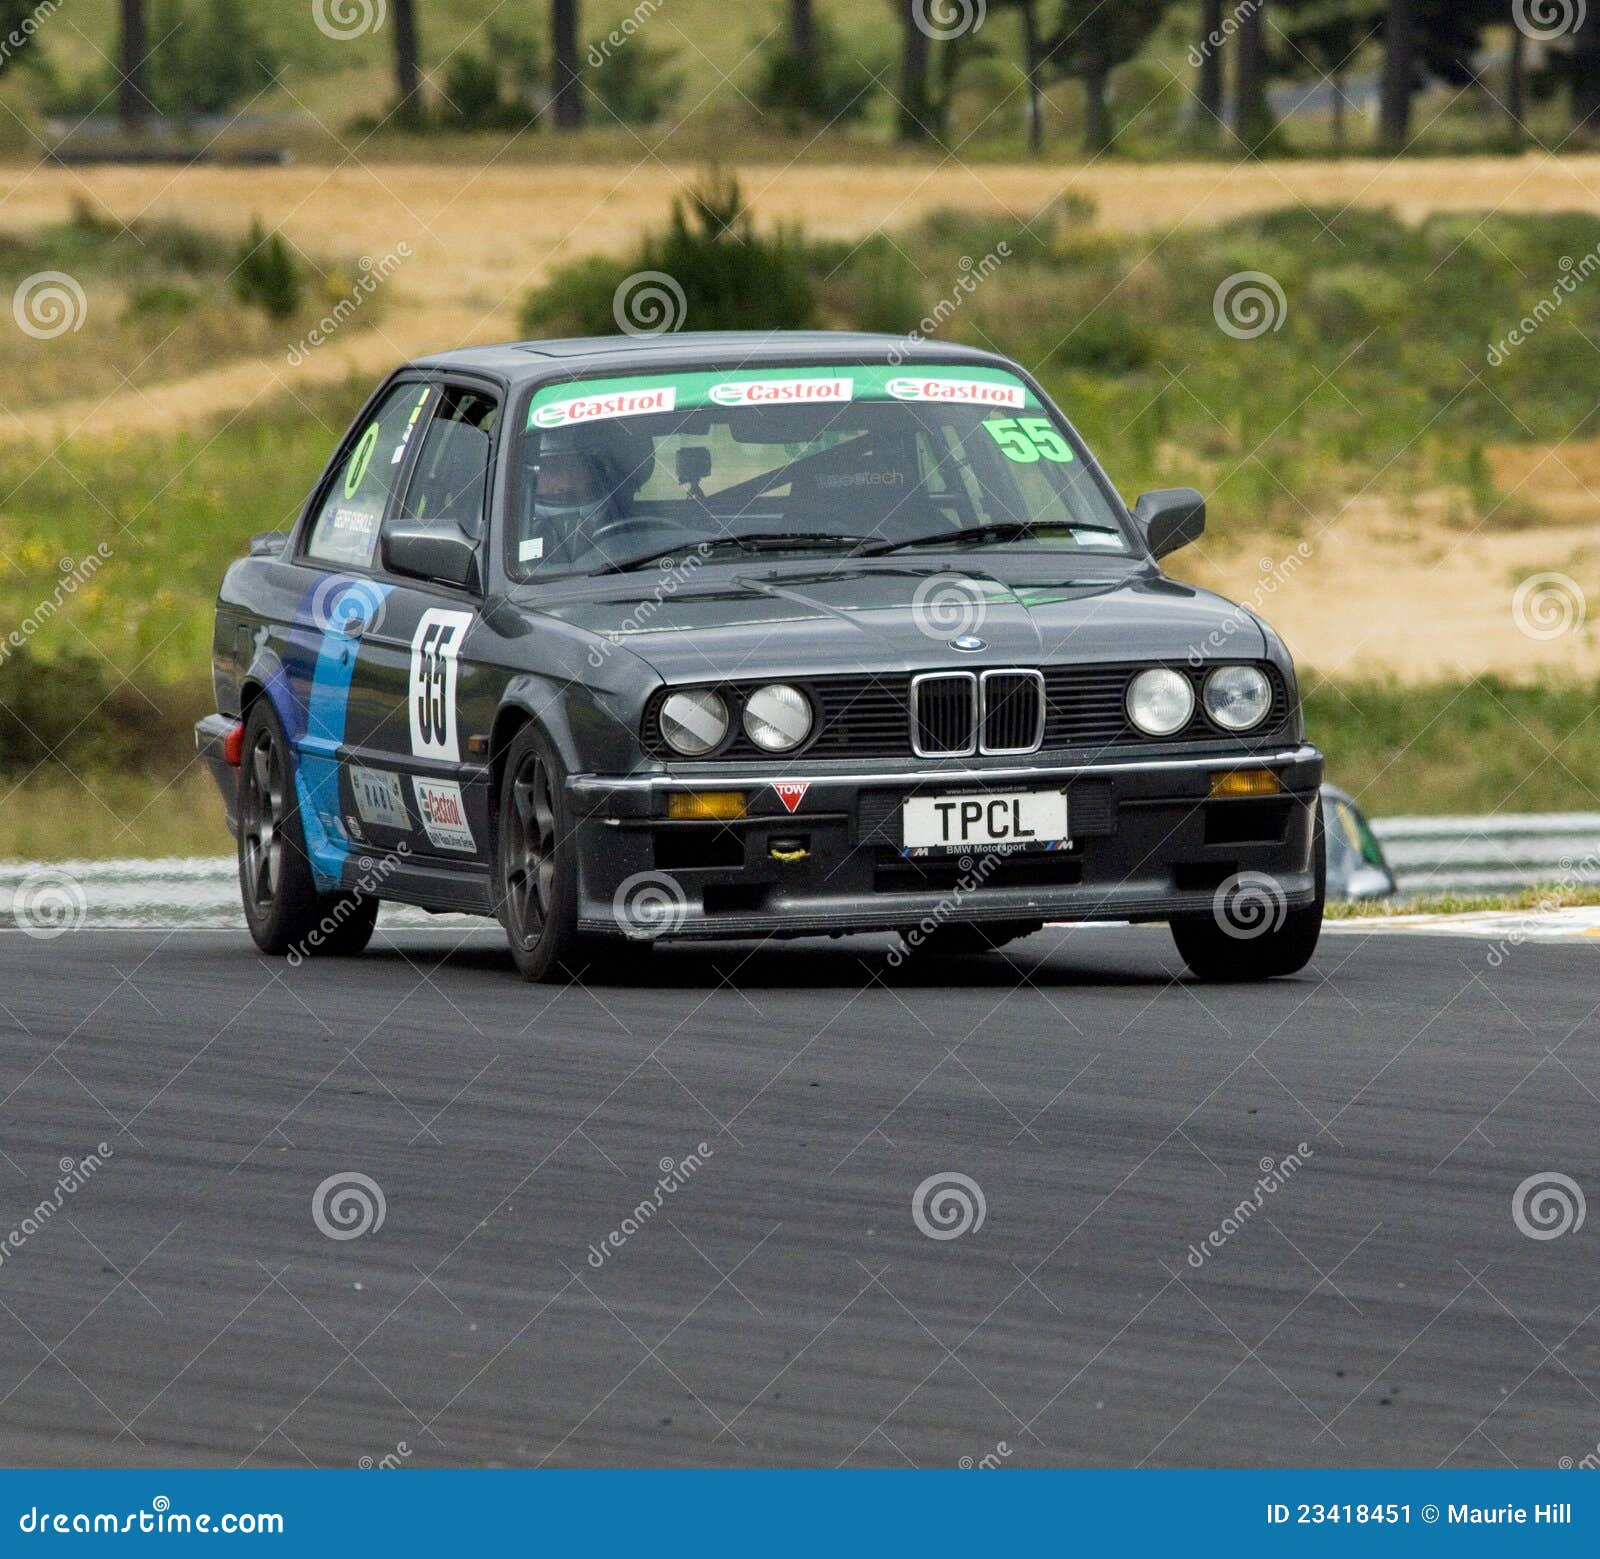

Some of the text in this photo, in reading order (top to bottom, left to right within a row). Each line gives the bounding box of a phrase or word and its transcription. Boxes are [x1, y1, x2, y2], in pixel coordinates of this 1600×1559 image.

[568, 392, 664, 419] Castrol
[746, 383, 843, 401] Castrol
[922, 382, 1017, 403] Castrol
[981, 418, 1074, 464] 55
[418, 624, 456, 747] 55
[777, 784, 804, 795] TOW
[428, 789, 463, 826] Castrol
[934, 800, 1035, 841] TPCL
[946, 842, 1026, 855] BMW Motorsport
